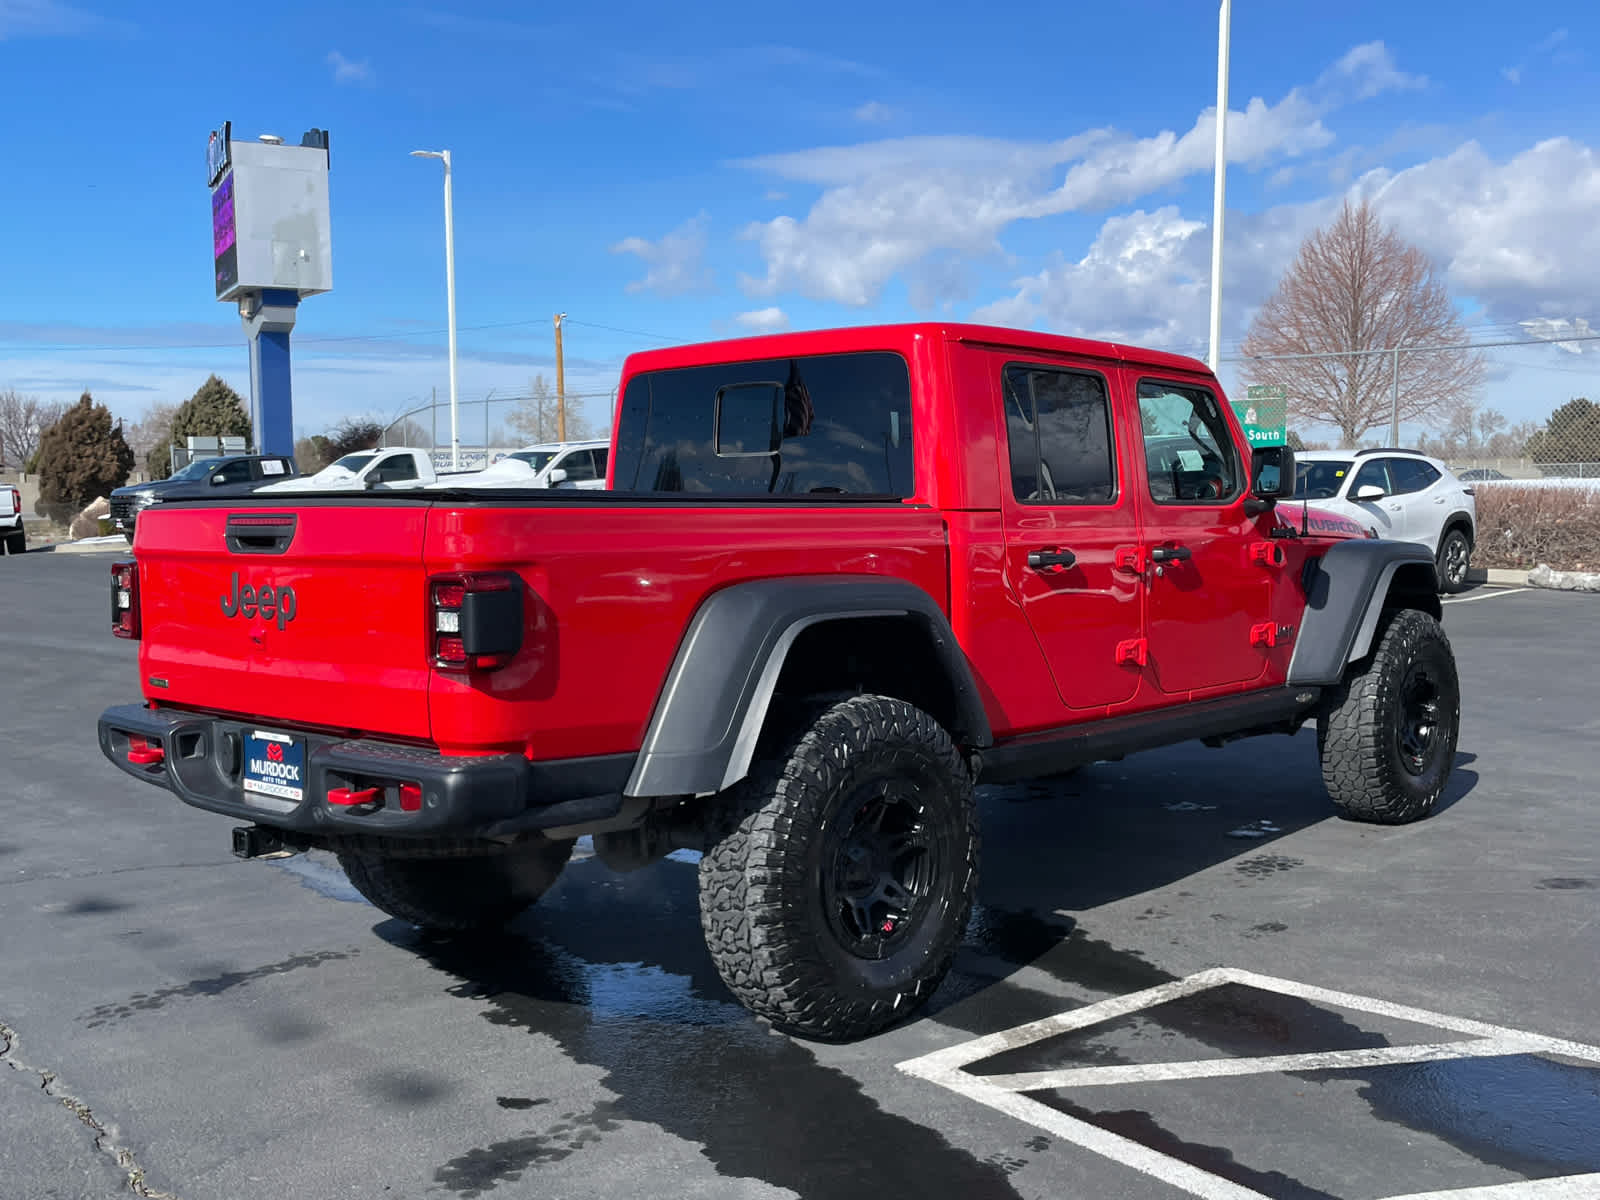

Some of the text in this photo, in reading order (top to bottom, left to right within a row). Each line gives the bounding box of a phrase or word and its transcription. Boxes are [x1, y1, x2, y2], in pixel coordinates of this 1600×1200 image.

[1248, 429, 1280, 441] South
[220, 571, 297, 631] Jeep
[250, 758, 299, 780] MURDOCK
